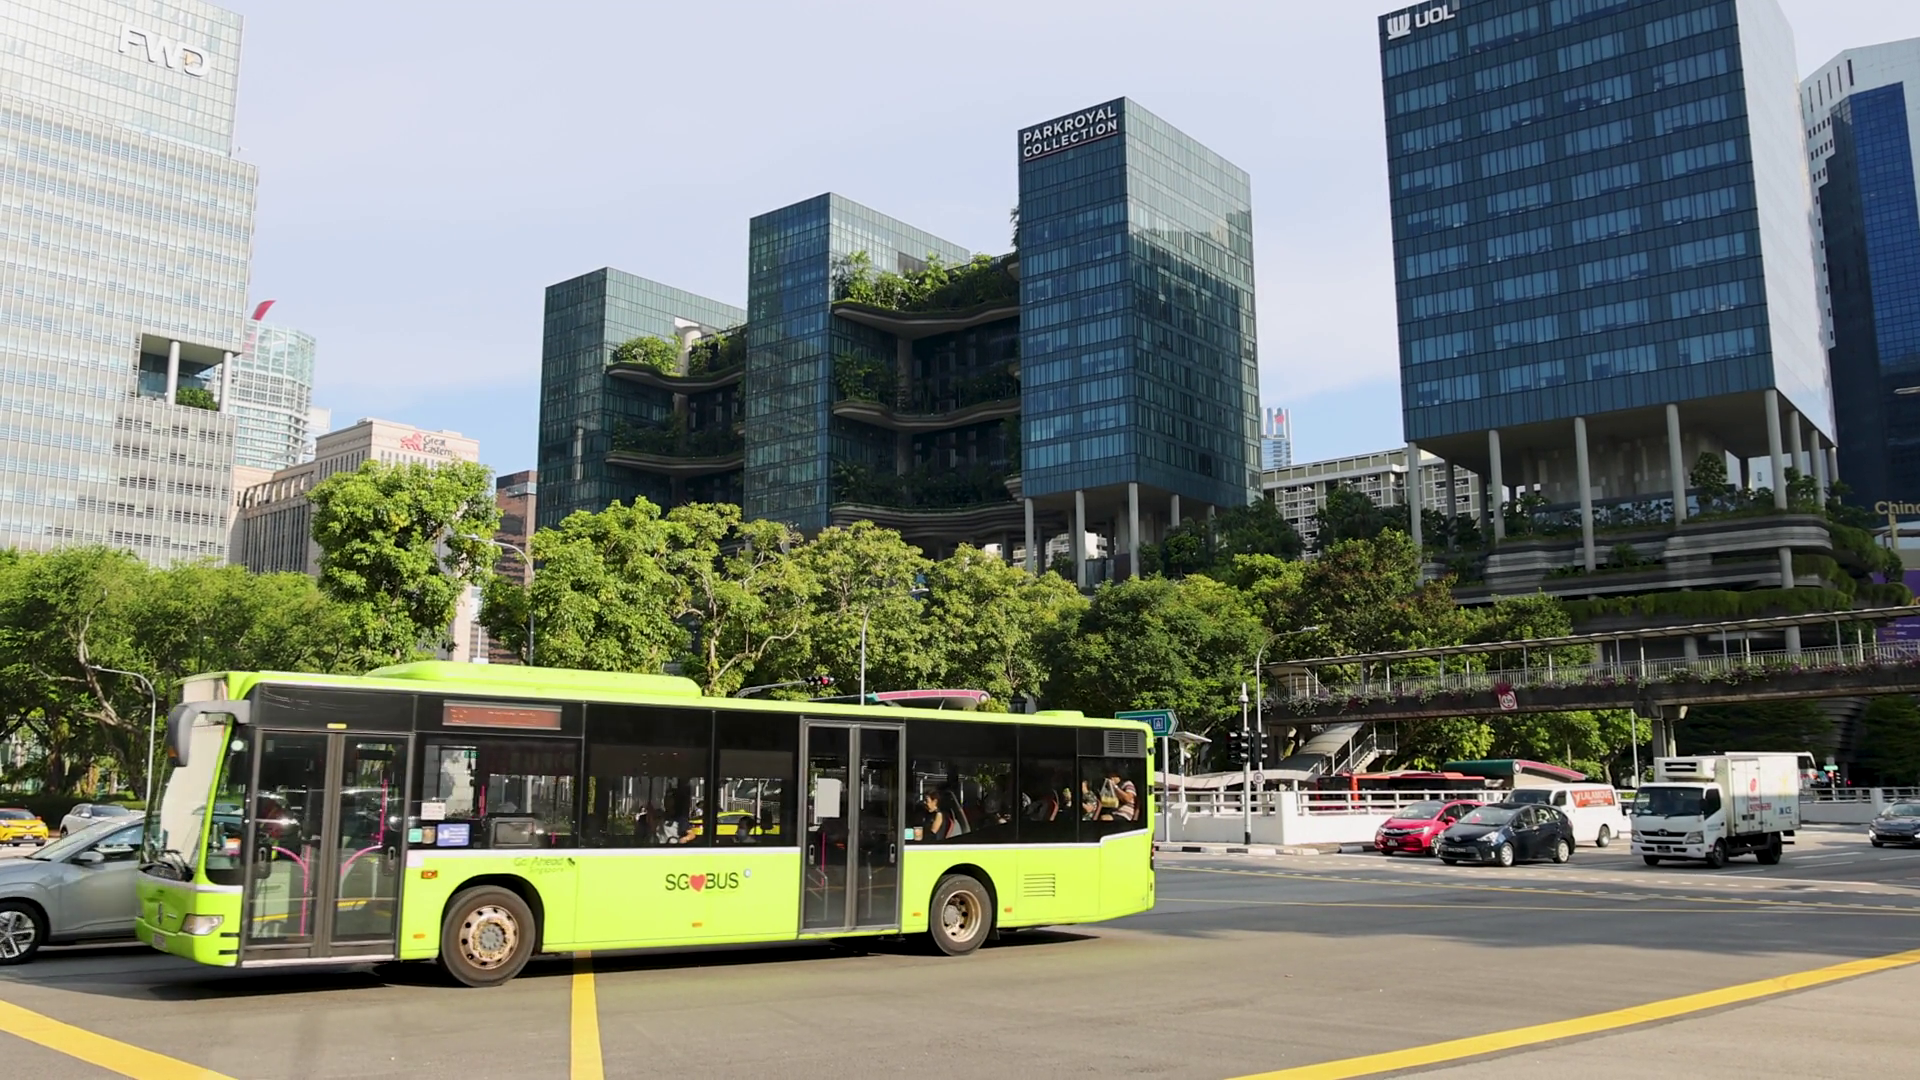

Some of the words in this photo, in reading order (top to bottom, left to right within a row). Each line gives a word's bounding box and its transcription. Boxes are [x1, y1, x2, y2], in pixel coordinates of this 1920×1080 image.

[1415, 4, 1456, 28] UOL
[117, 23, 211, 77] FWD
[1023, 105, 1117, 145] PARKROYAL
[1023, 119, 1118, 158] COLLECTION
[423, 434, 446, 447] Great
[423, 443, 453, 458] Eastern
[529, 856, 564, 867] Ahead
